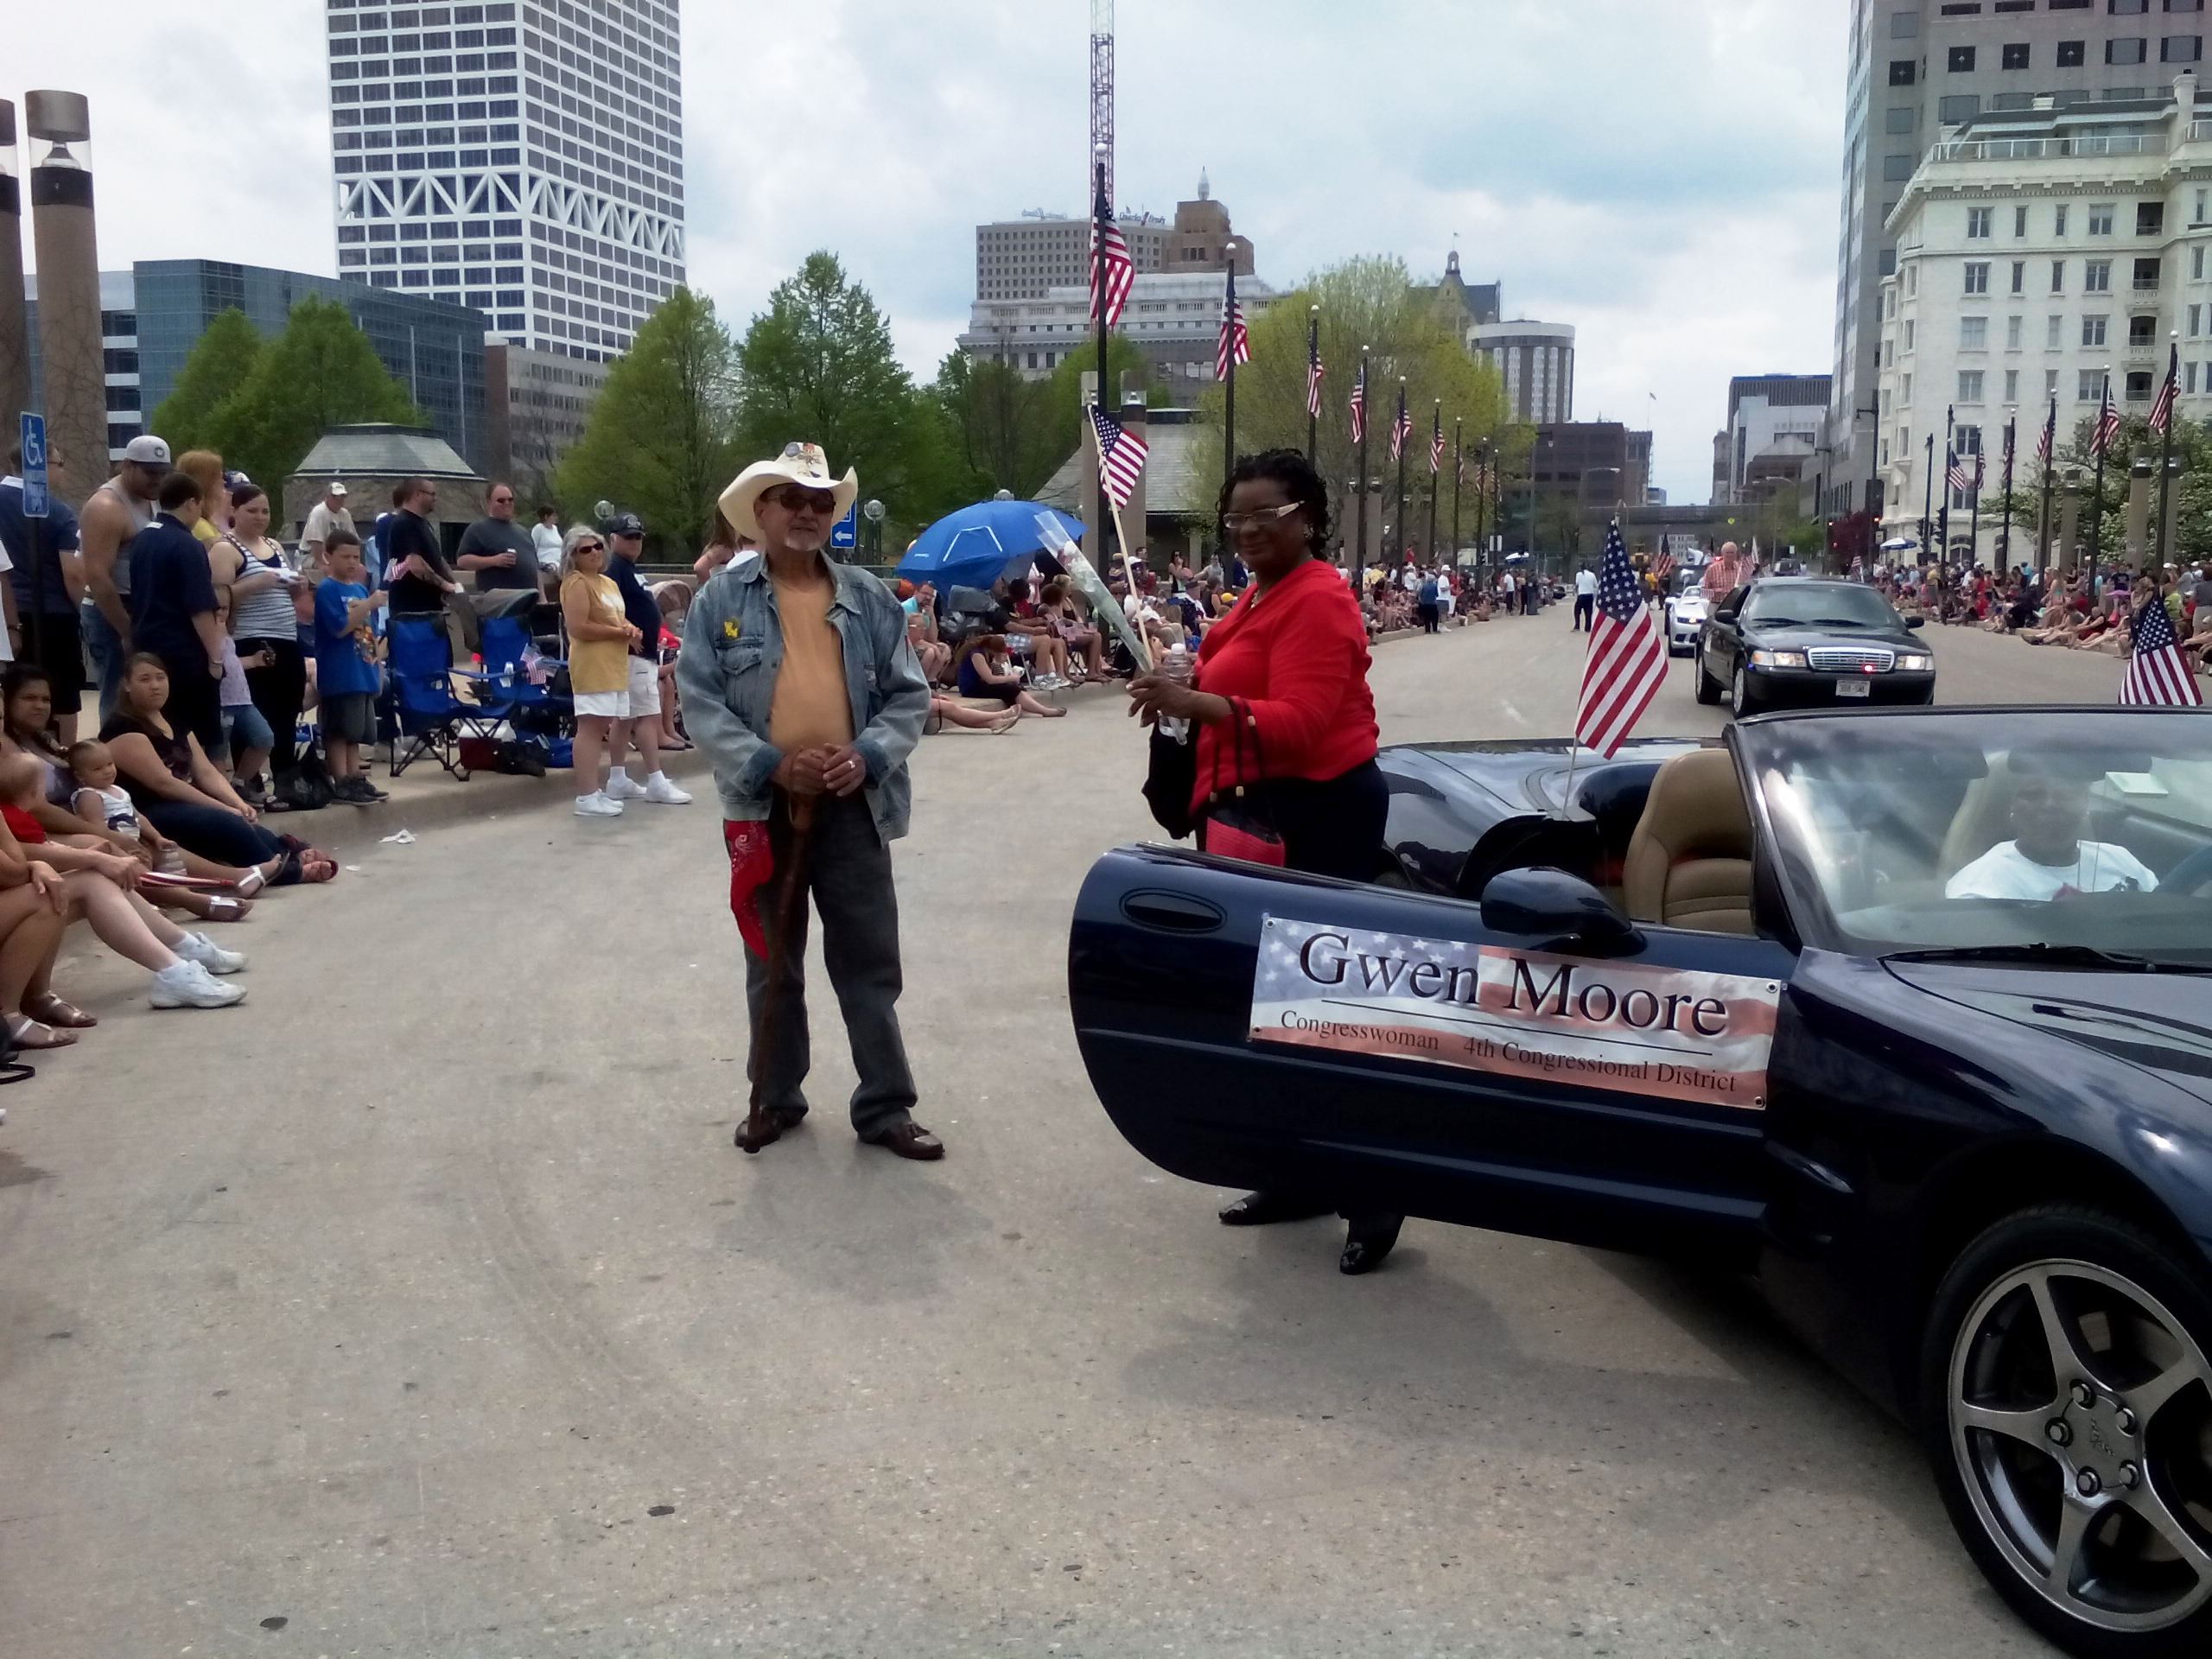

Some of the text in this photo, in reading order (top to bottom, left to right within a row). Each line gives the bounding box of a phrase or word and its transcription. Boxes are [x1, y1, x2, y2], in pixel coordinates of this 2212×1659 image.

[1299, 931, 1727, 1037] Gwen Moore
[1281, 1009, 1738, 1093] Congresswoman 4th Congressional District
